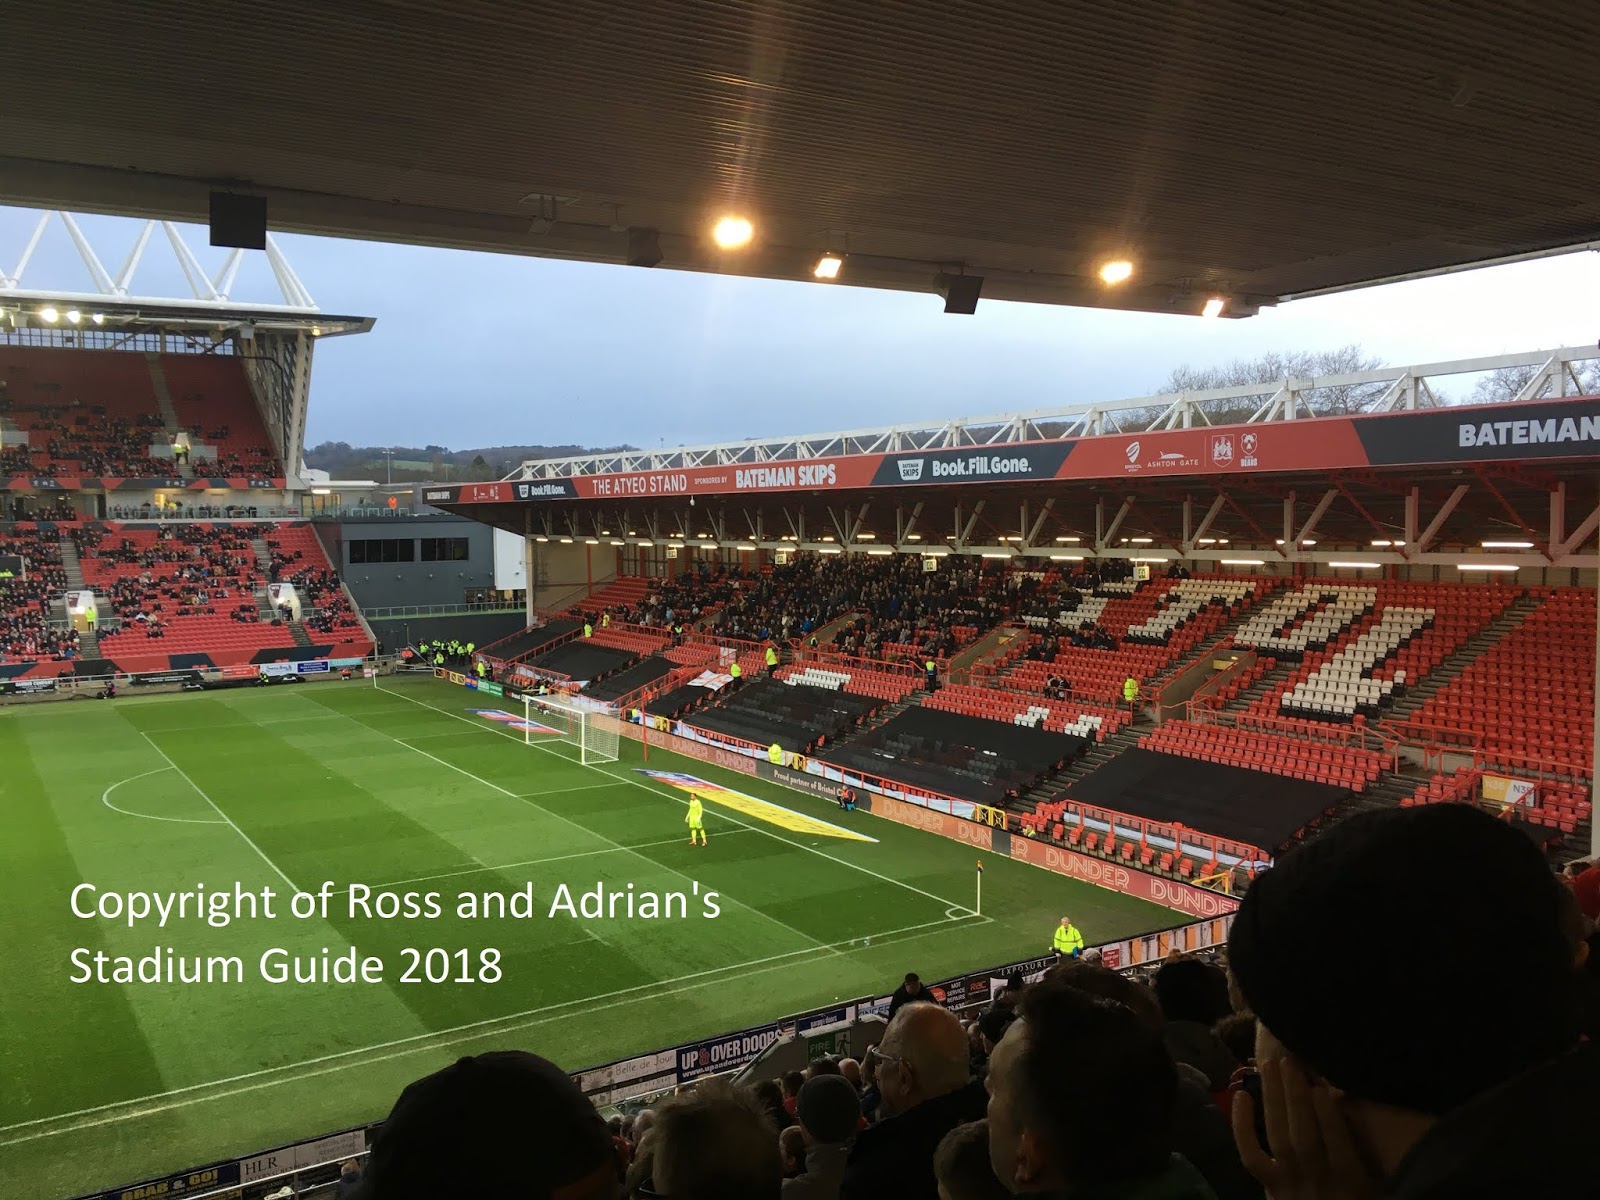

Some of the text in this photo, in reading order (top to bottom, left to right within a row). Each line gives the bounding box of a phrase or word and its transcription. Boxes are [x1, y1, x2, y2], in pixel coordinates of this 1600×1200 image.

[1459, 415, 1600, 447] BATEMAN
[902, 468, 919, 477] SKIPS
[932, 456, 1032, 477] Book.Fill.Gone.
[1147, 459, 1199, 468] ASHTON GATE
[593, 478, 611, 496] THE
[613, 475, 648, 495] ATYEO
[649, 473, 688, 493] STAND
[735, 467, 795, 489] BATEMAN
[798, 463, 837, 487] SKIPS
[715, 747, 757, 776] DUNDER
[774, 769, 789, 785] Proud
[790, 775, 810, 792] partner
[817, 780, 836, 797] Bristol
[882, 799, 944, 832] DUNDER
[1045, 847, 1130, 890] DUNDER
[1150, 878, 1239, 917] DUNDE
[1001, 960, 1047, 977] EXPOSURE
[946, 986, 965, 998] SERVICE
[951, 981, 962, 989] MOT
[947, 993, 966, 1004] REPAIRS
[681, 1051, 699, 1071] UP
[700, 1047, 710, 1066] &
[711, 1039, 741, 1063] OVER
[810, 1040, 831, 1054] FIRE
[615, 1062, 638, 1076] Belle
[639, 1060, 651, 1070] de
[655, 1053, 673, 1066] Jour
[245, 1156, 278, 1176] HLR
[121, 1182, 169, 1200] GRAB
[173, 1179, 186, 1190] &
[189, 1168, 219, 1186] GO!
